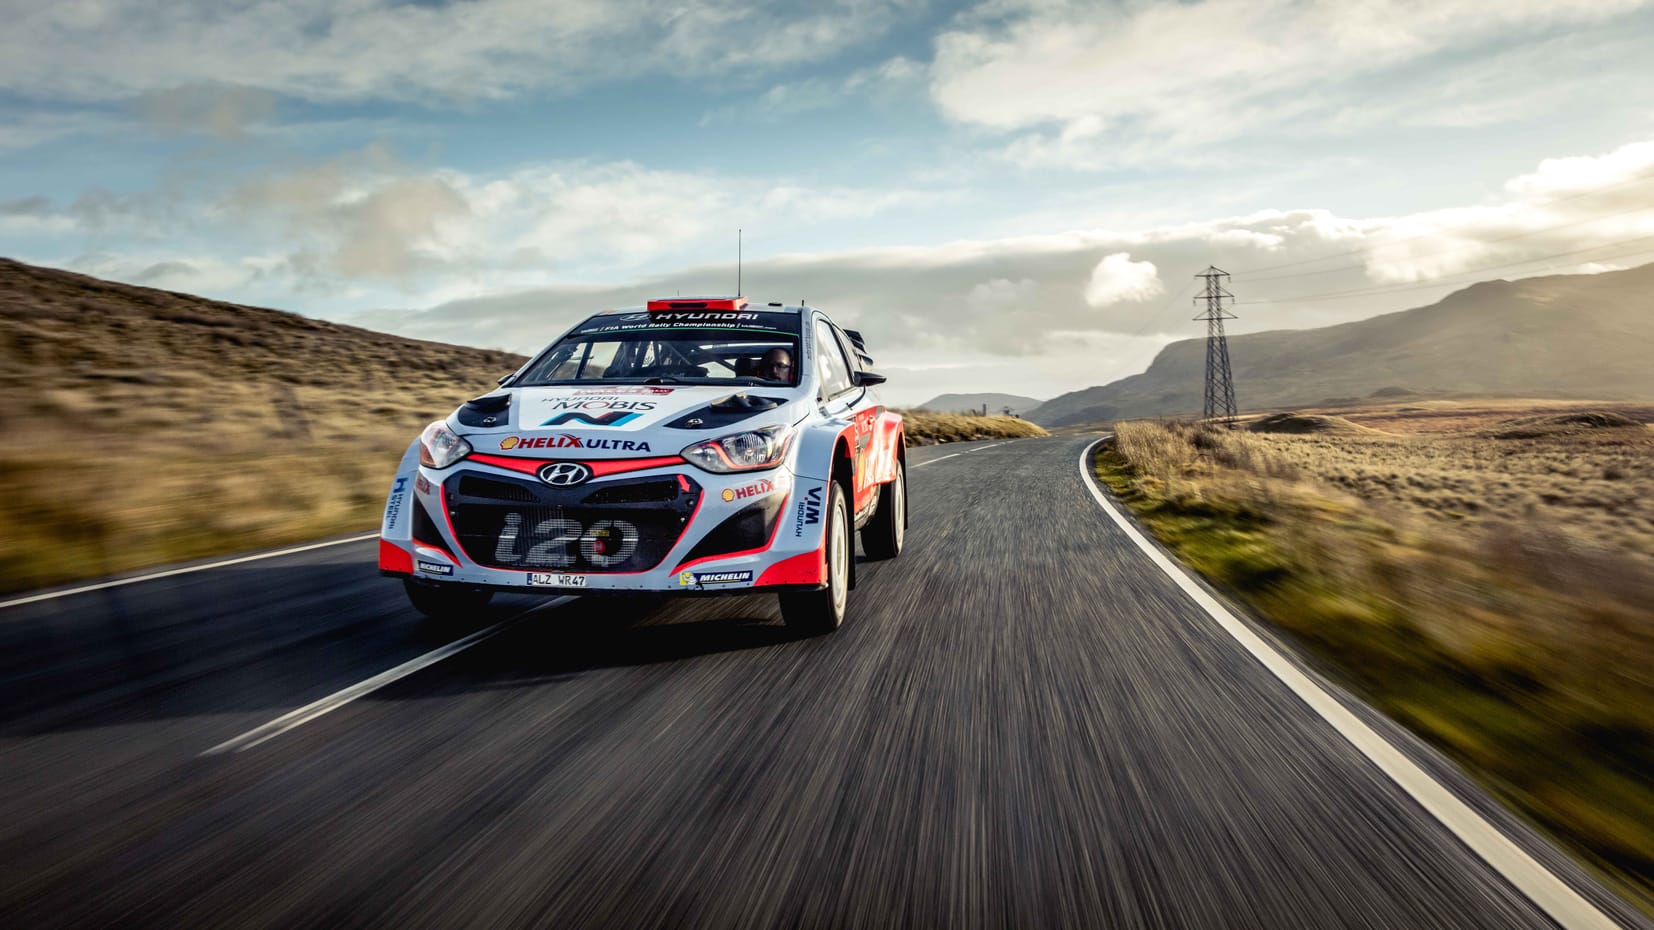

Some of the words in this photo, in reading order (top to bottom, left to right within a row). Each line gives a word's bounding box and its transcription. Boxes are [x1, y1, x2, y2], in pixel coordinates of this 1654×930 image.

[655, 312, 759, 320] HYUNDAI
[673, 321, 735, 329] Championship
[552, 400, 658, 411] MOBIS
[518, 433, 584, 449] HELIX
[586, 438, 651, 452] ULTRA
[804, 486, 823, 525] WIA
[795, 501, 806, 538] HYUNDAI
[533, 574, 551, 585] ALZ
[558, 574, 586, 586] WR47
[700, 572, 750, 581] MICHELIN
